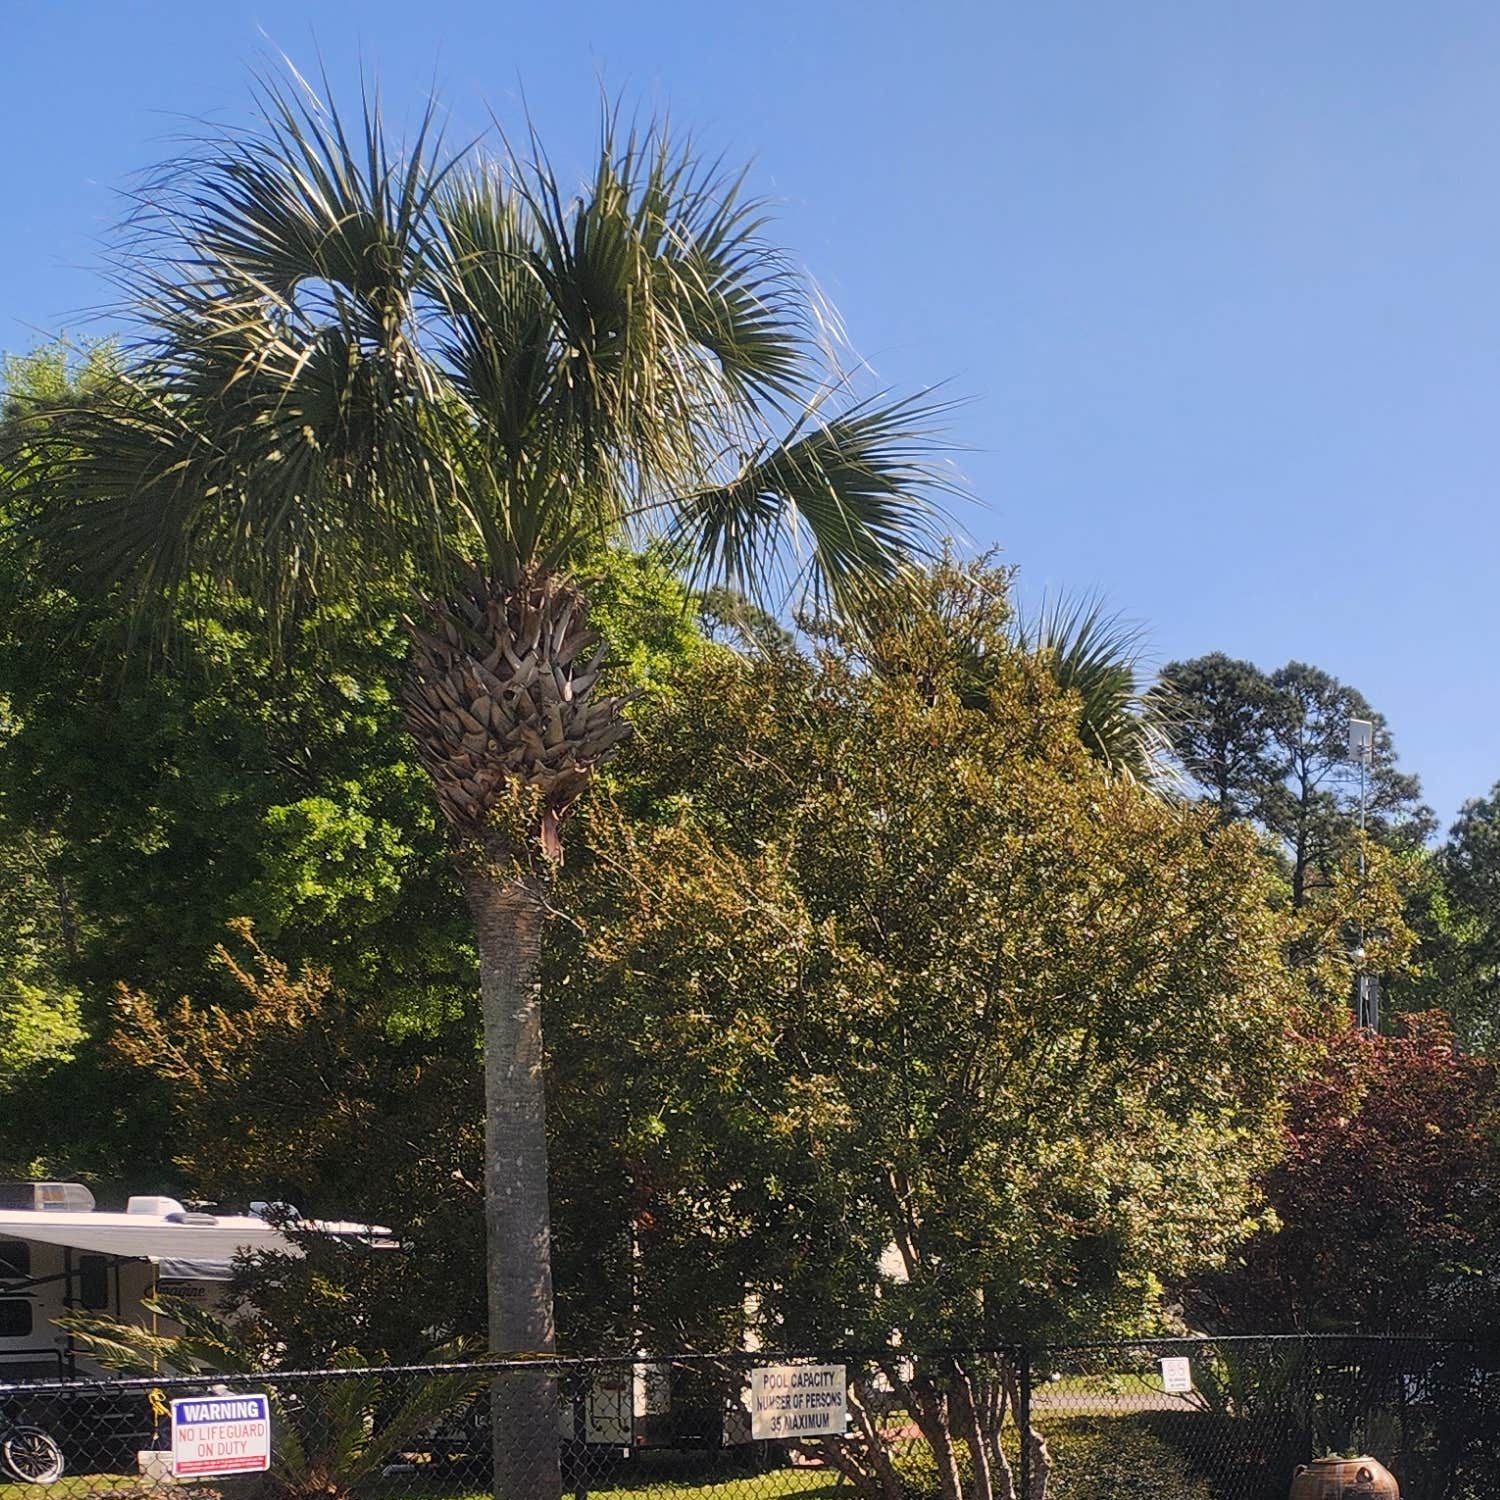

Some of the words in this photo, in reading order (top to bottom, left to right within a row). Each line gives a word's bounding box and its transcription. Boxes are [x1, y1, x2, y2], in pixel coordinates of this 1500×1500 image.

[763, 1374, 789, 1389] POOL
[791, 1371, 835, 1388] CAPACITY
[757, 1394, 791, 1411] NUMBER
[793, 1393, 804, 1409] OF
[805, 1392, 842, 1408] PERSONS
[183, 1401, 259, 1422] WARNING
[771, 1416, 781, 1431] 35
[784, 1413, 830, 1430] MAXIMUM
[178, 1428, 195, 1442] NO
[199, 1423, 265, 1441] LIFEGUARD
[198, 1444, 213, 1457] ON
[218, 1441, 248, 1456] DUTY
